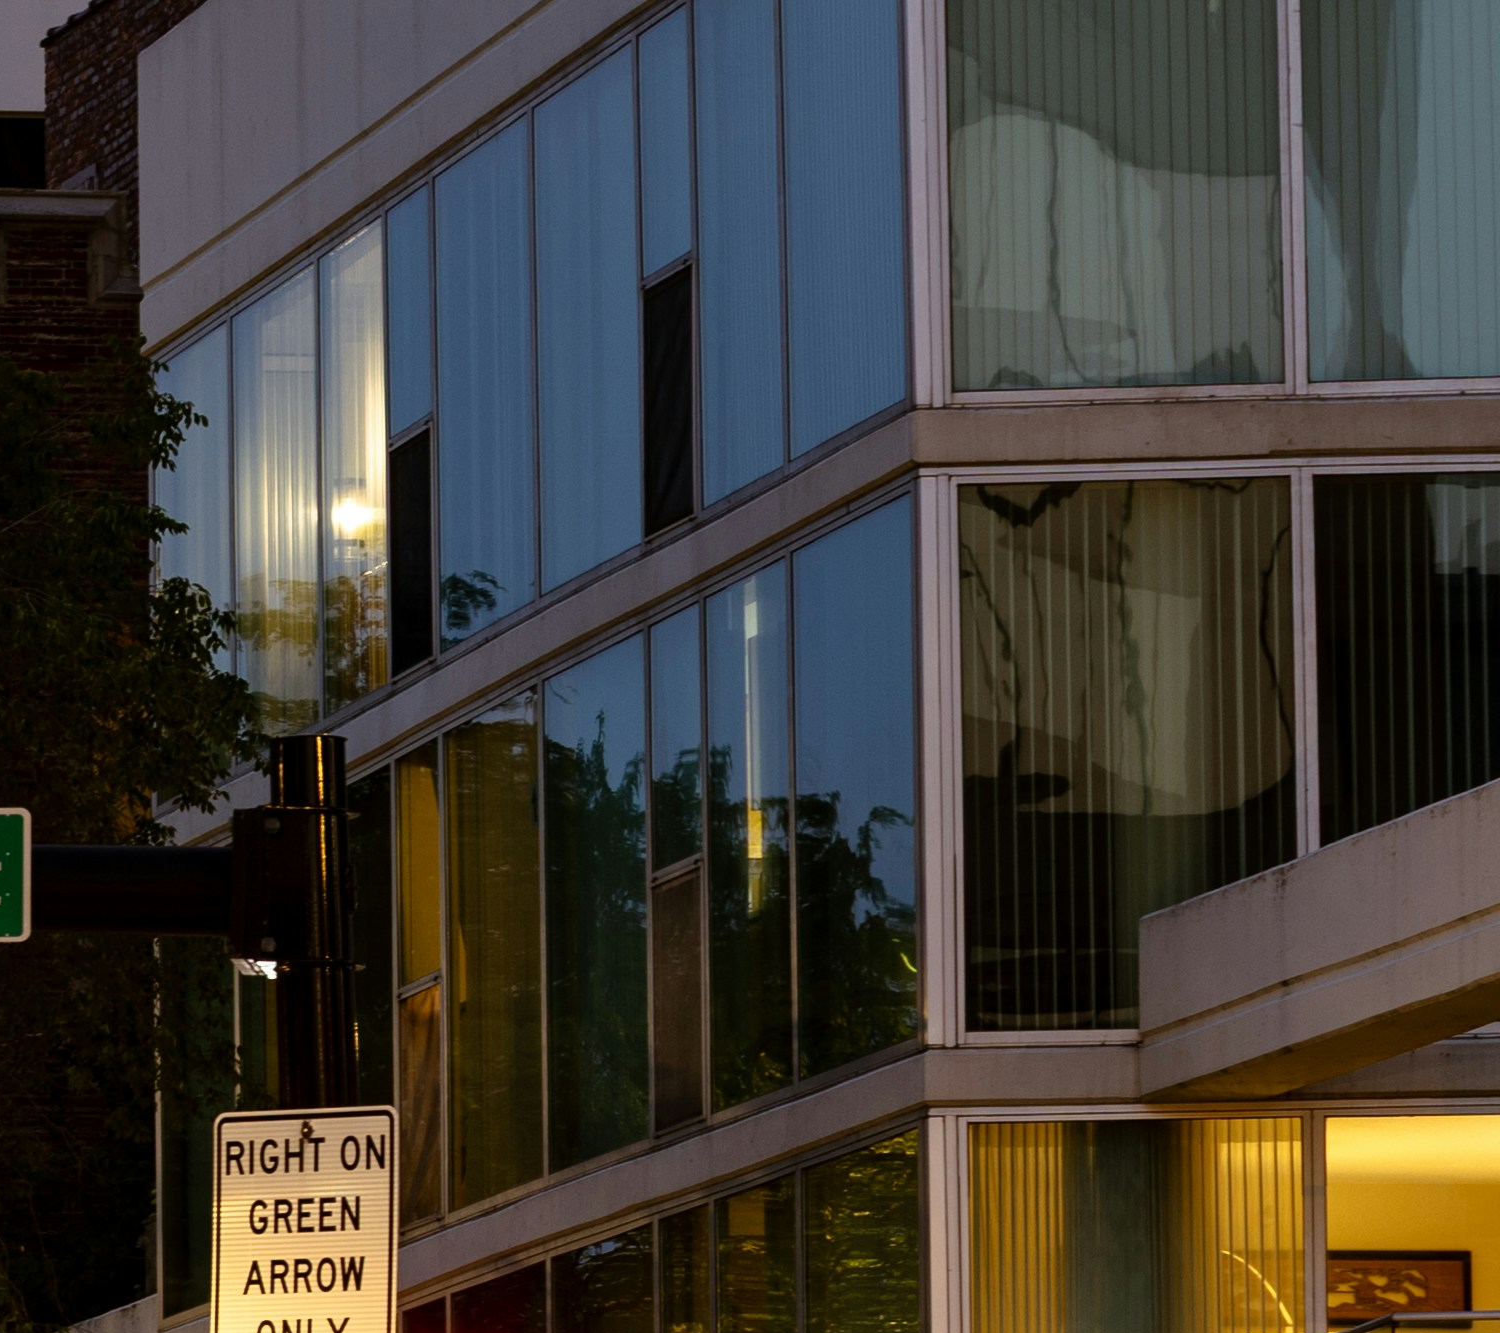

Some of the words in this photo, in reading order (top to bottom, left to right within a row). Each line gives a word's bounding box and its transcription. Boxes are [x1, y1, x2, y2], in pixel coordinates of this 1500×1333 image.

[225, 1136, 326, 1177] RIGHT
[340, 1134, 387, 1171] ON
[248, 1195, 361, 1236] GREEN
[243, 1255, 366, 1296] ARROW
